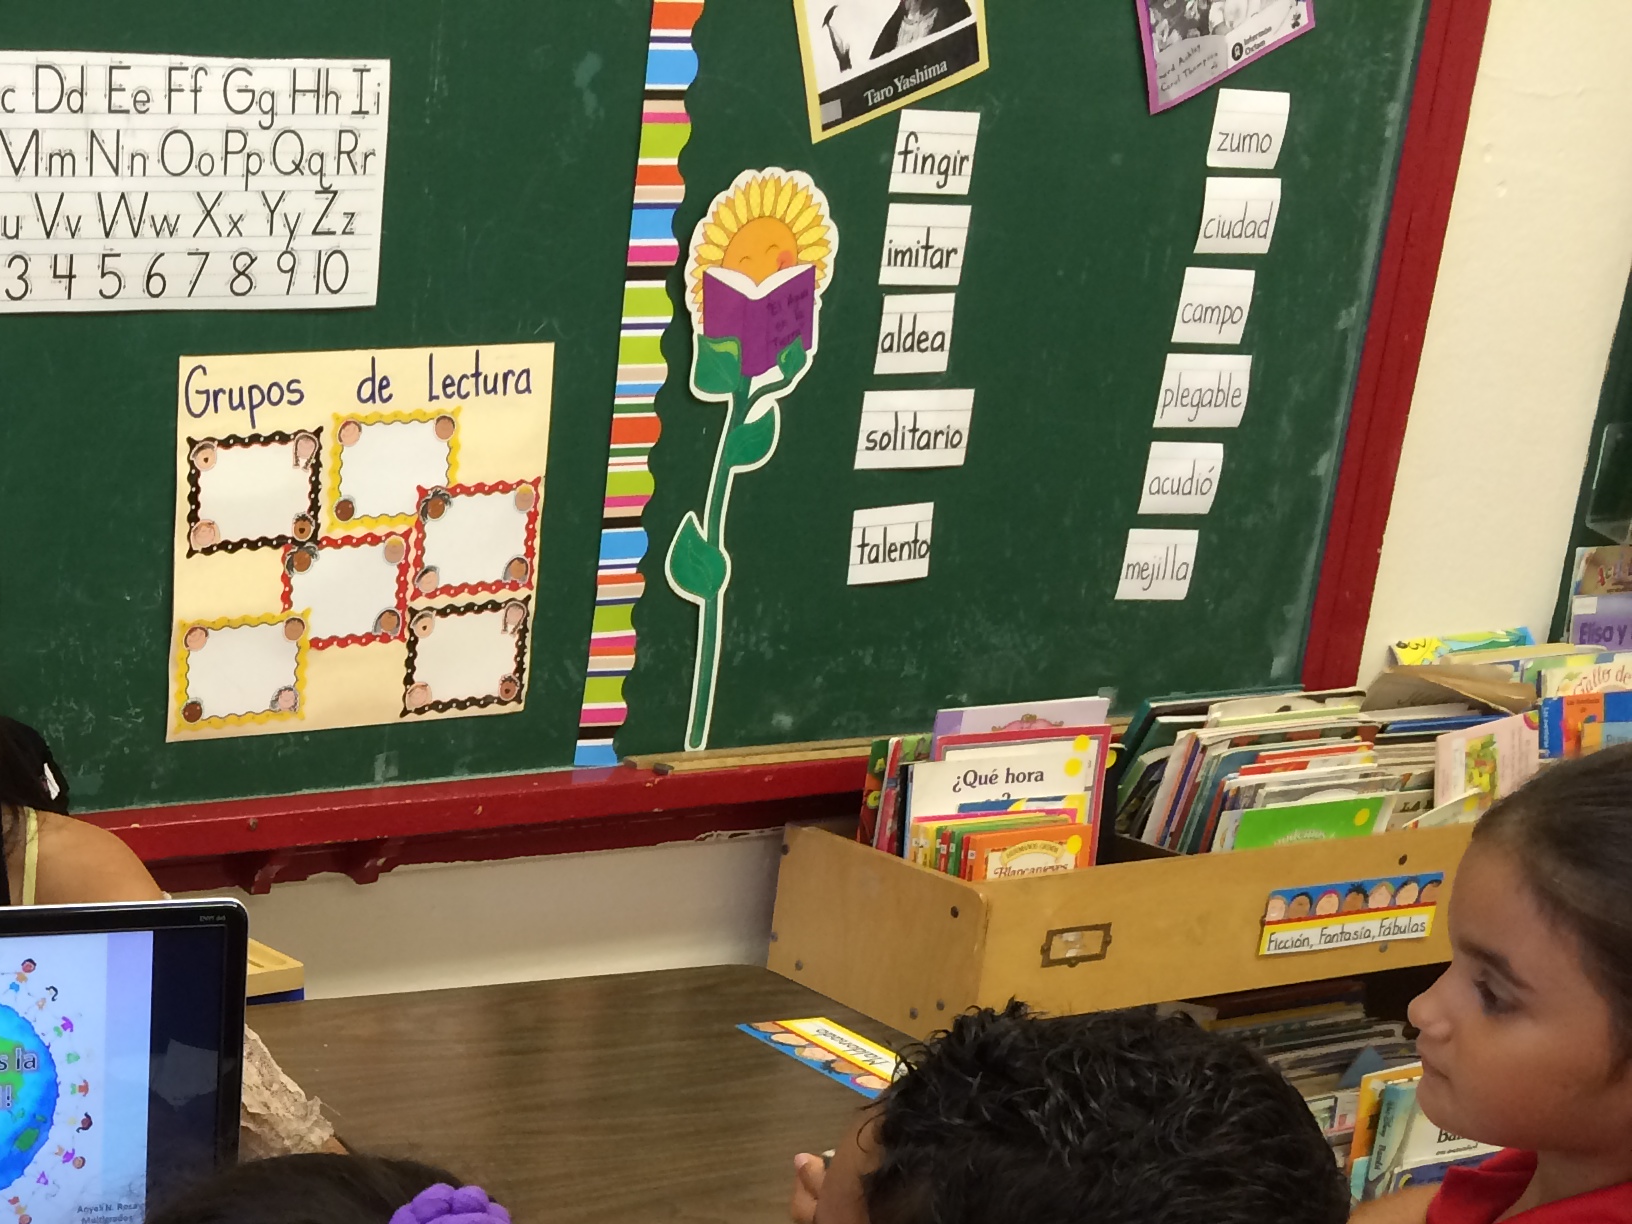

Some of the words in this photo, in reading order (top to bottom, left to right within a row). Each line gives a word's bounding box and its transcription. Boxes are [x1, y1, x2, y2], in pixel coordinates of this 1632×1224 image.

[34, 64, 85, 114] Dd
[107, 65, 151, 114] Ee
[168, 66, 208, 115] Ff
[223, 67, 277, 129] Gg
[292, 68, 340, 115] Hh
[350, 68, 381, 115] Ii
[863, 86, 894, 106] Taro
[893, 60, 948, 93] Yashima
[89, 128, 147, 177] Nn
[160, 129, 215, 177] Oo
[223, 129, 263, 191] Pp
[271, 129, 332, 191] Qq
[337, 129, 376, 177] Rr
[898, 131, 969, 189] fingir
[1217, 131, 1272, 154] zumo
[35, 192, 82, 240] Vv
[97, 191, 181, 239] Ww
[193, 191, 244, 238] Xx
[261, 190, 302, 250] Yy
[311, 190, 356, 237] Zz
[1203, 200, 1273, 240] ciudad
[887, 226, 958, 270] imitar
[5, 255, 31, 301] 3
[52, 255, 77, 300] 4
[98, 253, 123, 299] 5
[145, 251, 167, 298] 6
[186, 251, 211, 298] 7
[230, 252, 258, 297] 8
[276, 251, 298, 296] 9
[314, 249, 349, 295] 10
[881, 312, 946, 353] aldea
[1181, 302, 1244, 335] campo
[184, 364, 305, 429] Grupos
[356, 356, 394, 404] de
[427, 349, 532, 402] Lectura
[1160, 371, 1242, 422] plegable
[865, 410, 963, 451] solitario
[1148, 459, 1215, 496] acudió
[857, 521, 930, 565] talento
[1124, 544, 1189, 591] mejilla
[952, 768, 999, 793] ¿Qué
[1004, 767, 1044, 785] hora
[1267, 932, 1314, 952] Ficción,
[1319, 924, 1375, 944] Fantasía,
[1378, 916, 1426, 938] Fábulas
[14, 1048, 39, 1072] la
